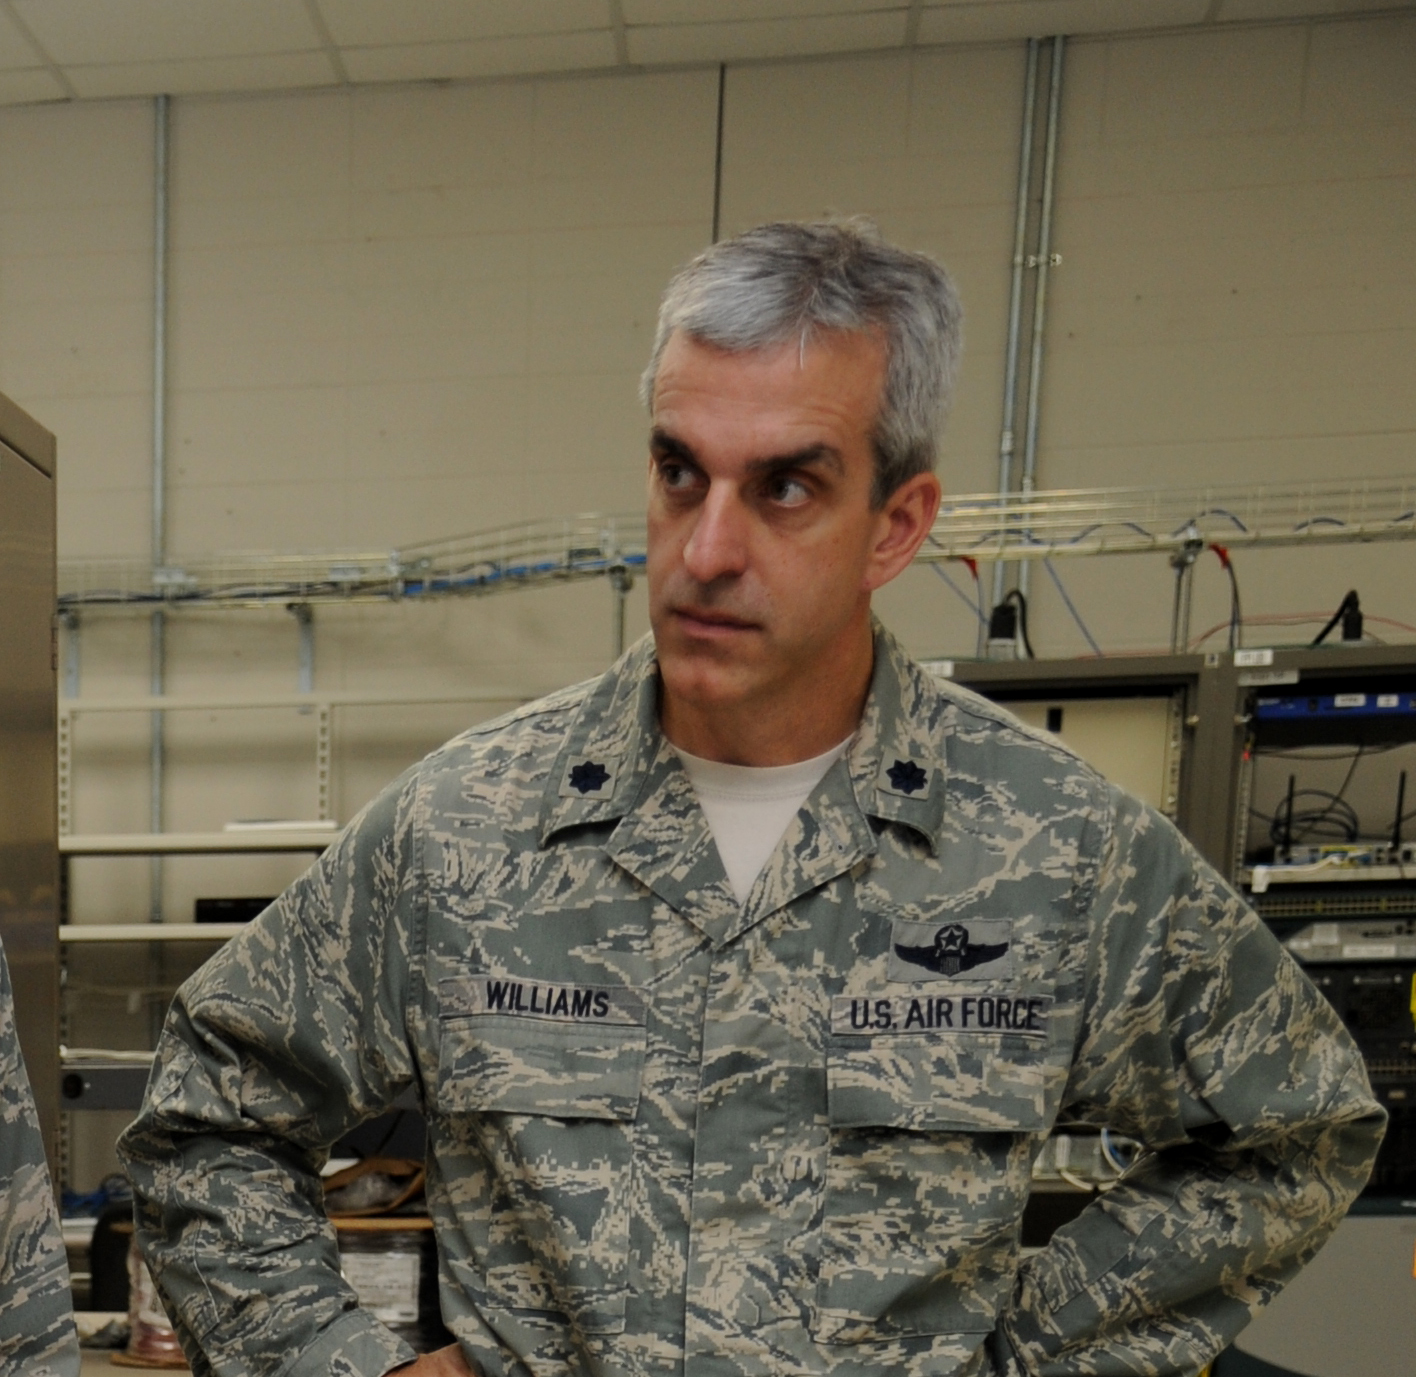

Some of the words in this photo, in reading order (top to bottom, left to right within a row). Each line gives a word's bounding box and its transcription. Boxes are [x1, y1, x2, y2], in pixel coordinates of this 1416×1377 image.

[486, 980, 610, 1018] WILLIAMS
[850, 999, 898, 1030] U.S.
[904, 997, 954, 1030] AIR
[961, 996, 1044, 1030] FORCE
